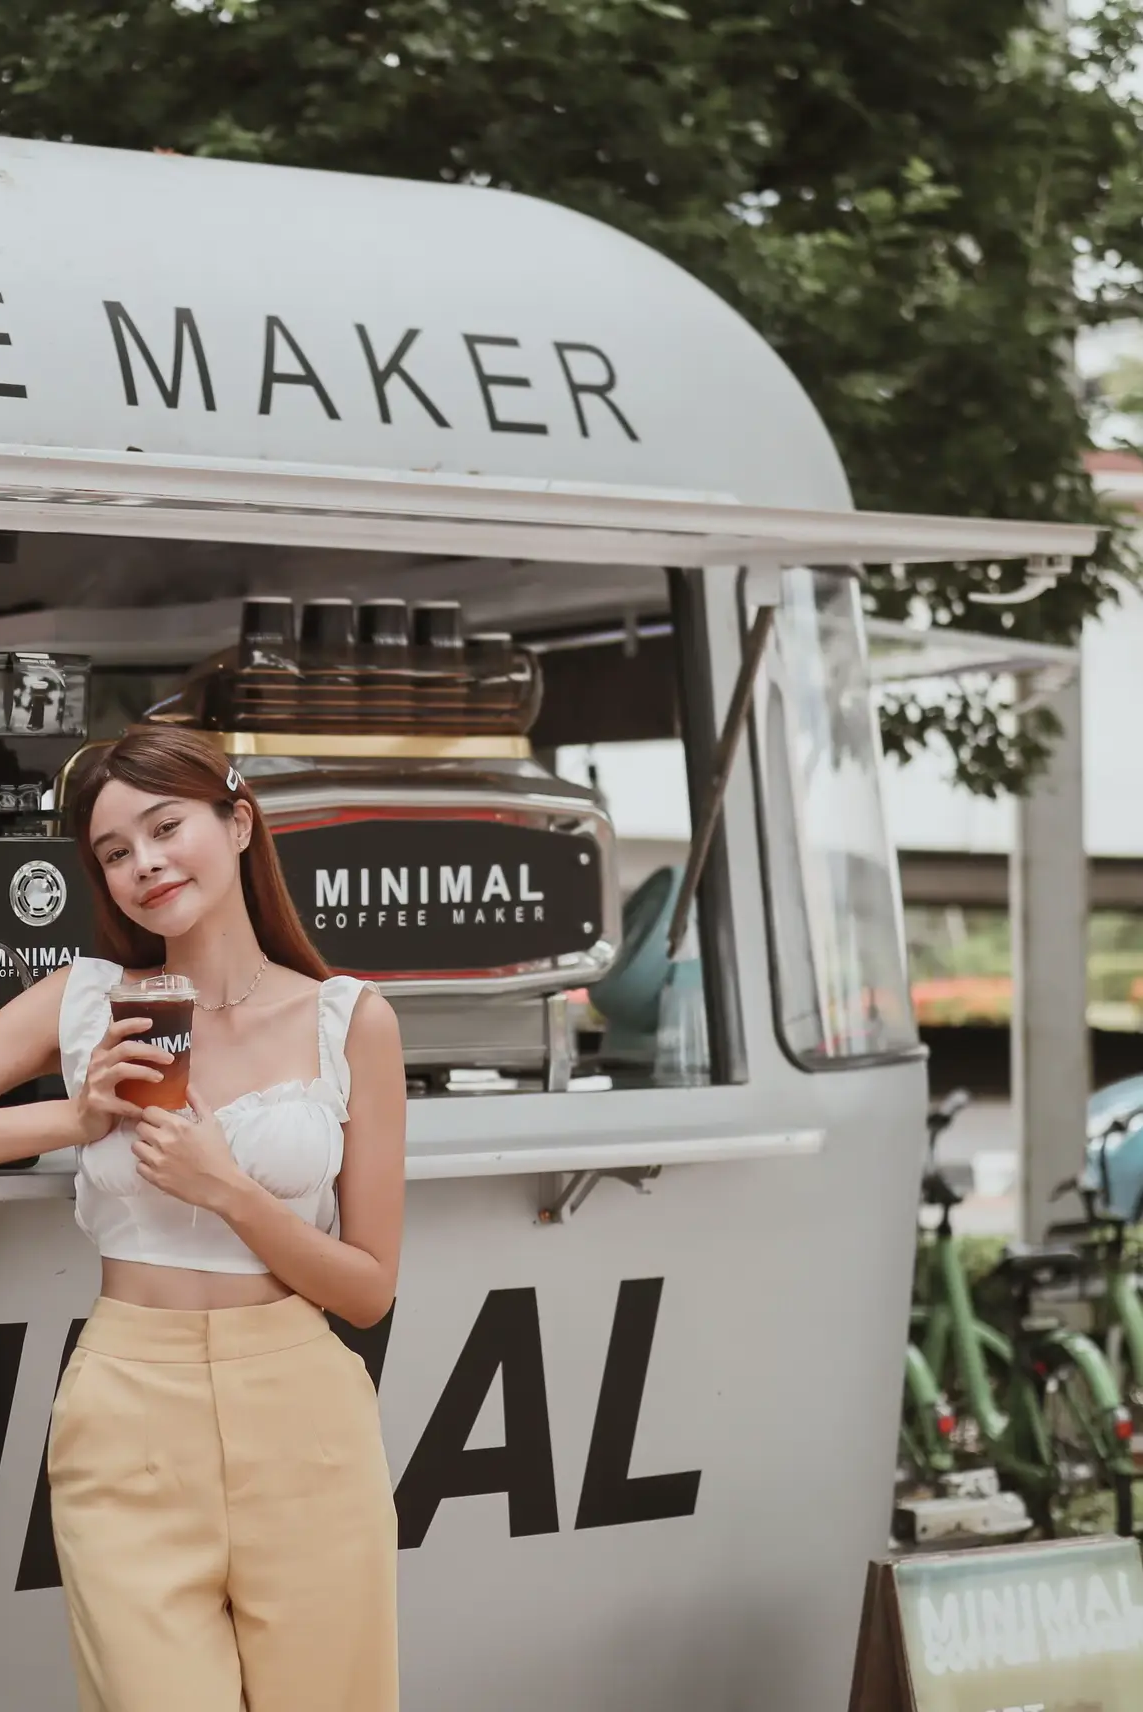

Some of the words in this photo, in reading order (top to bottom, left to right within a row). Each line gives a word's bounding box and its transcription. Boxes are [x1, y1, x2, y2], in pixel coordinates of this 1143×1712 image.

[102, 299, 641, 443] MAKER
[315, 863, 544, 907] MINIMAL
[315, 909, 427, 929] COFFEE
[452, 905, 544, 924] MAKER
